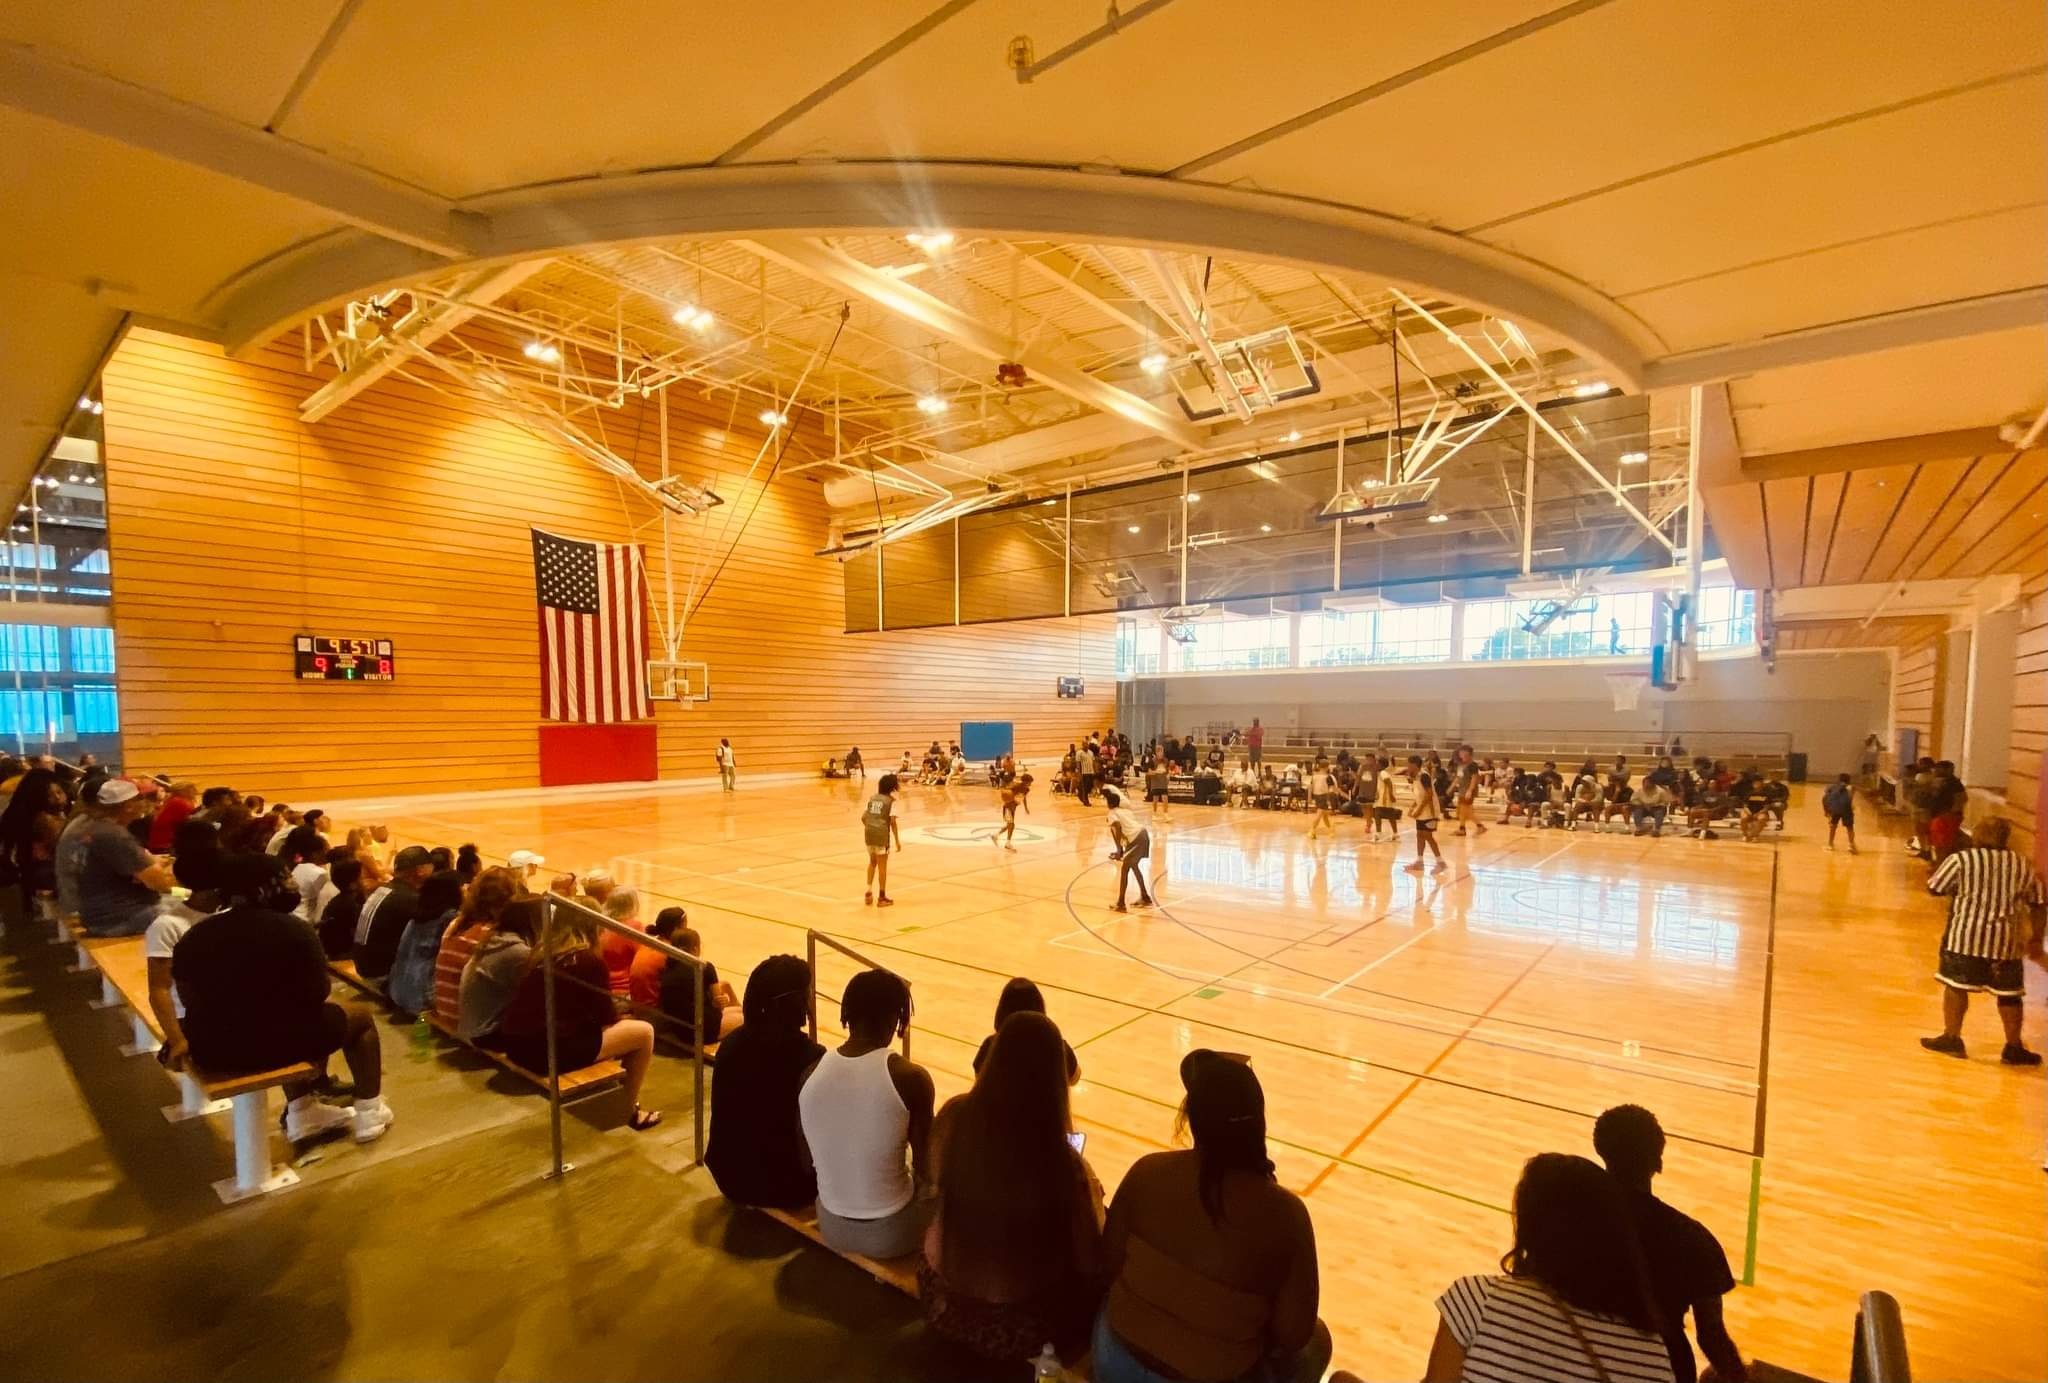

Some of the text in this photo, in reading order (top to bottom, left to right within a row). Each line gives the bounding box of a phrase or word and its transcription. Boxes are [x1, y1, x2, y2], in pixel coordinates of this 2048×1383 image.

[329, 639, 371, 655] 9:57
[315, 657, 327, 672] 9
[379, 660, 391, 673] 8
